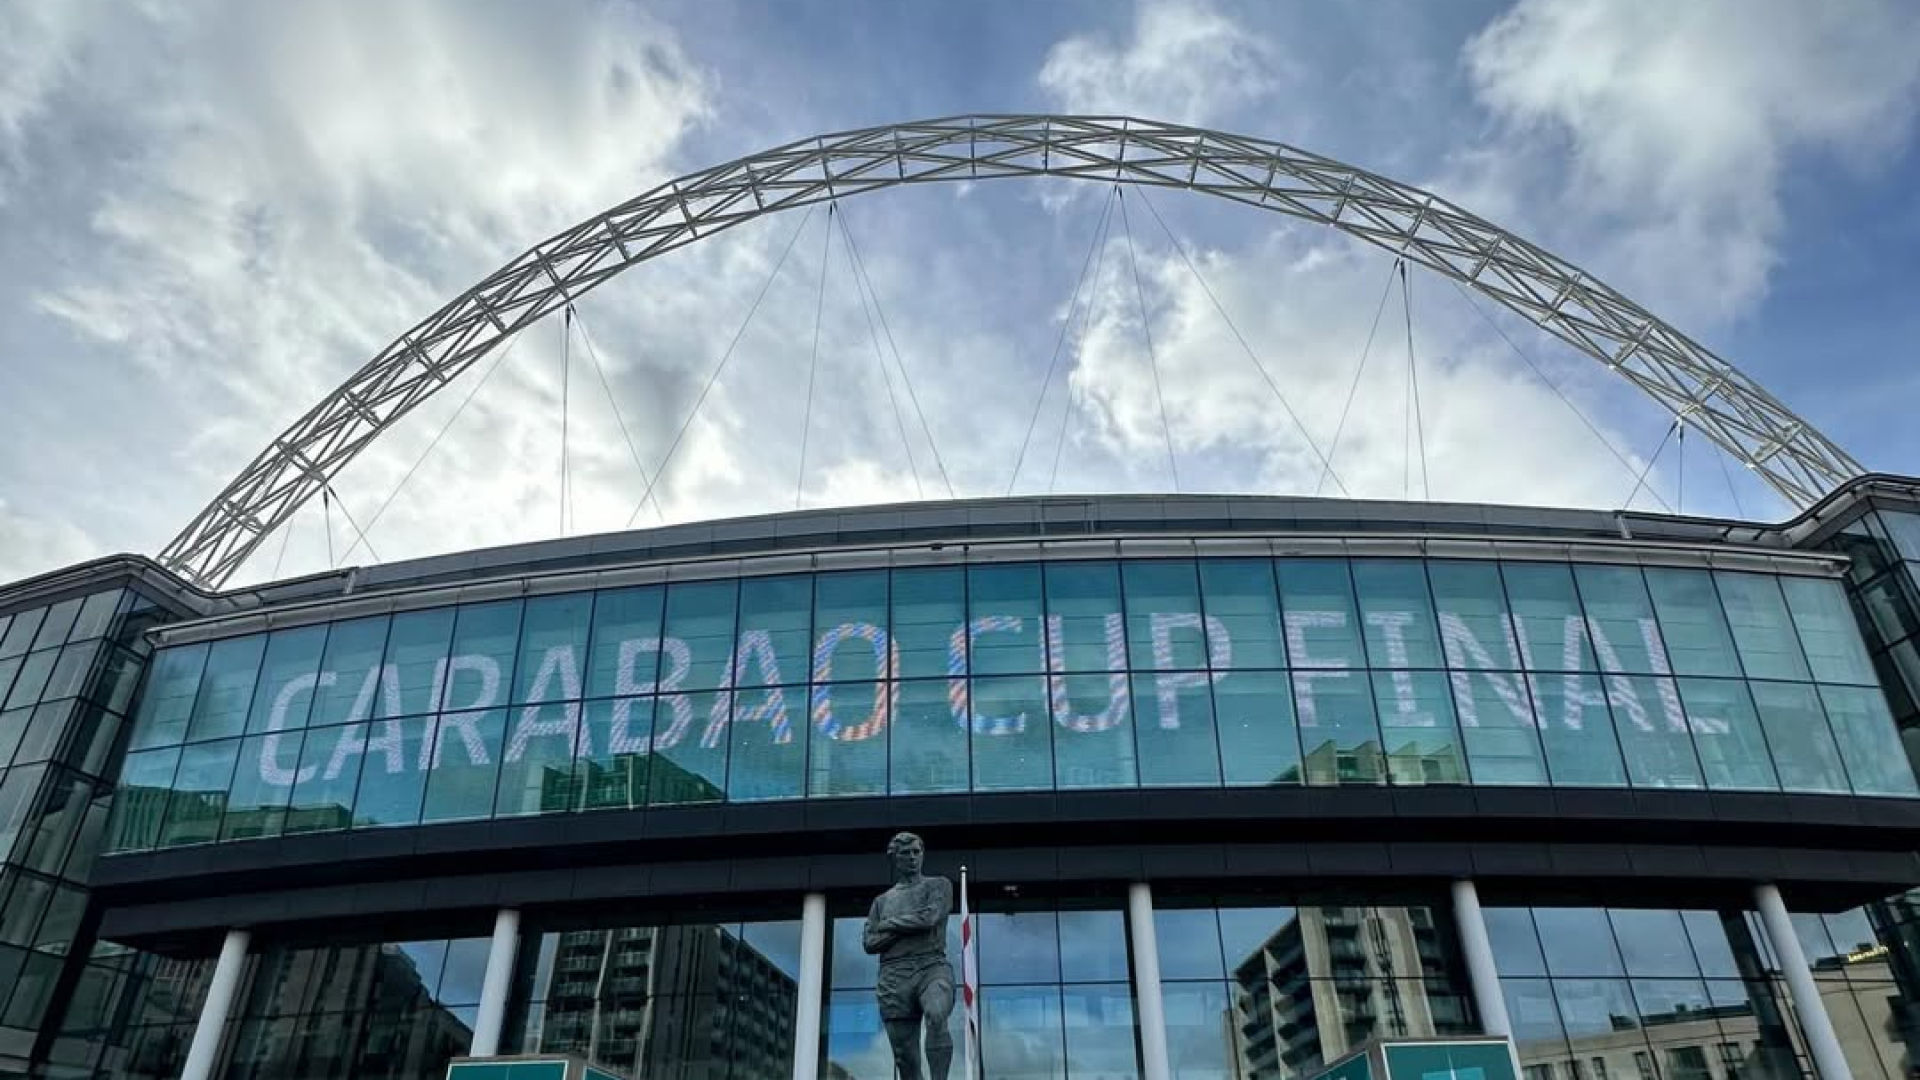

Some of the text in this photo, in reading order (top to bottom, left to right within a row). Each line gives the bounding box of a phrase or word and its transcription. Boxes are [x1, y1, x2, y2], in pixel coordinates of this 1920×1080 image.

[259, 611, 1729, 786] CARABAO CUP FINAL
